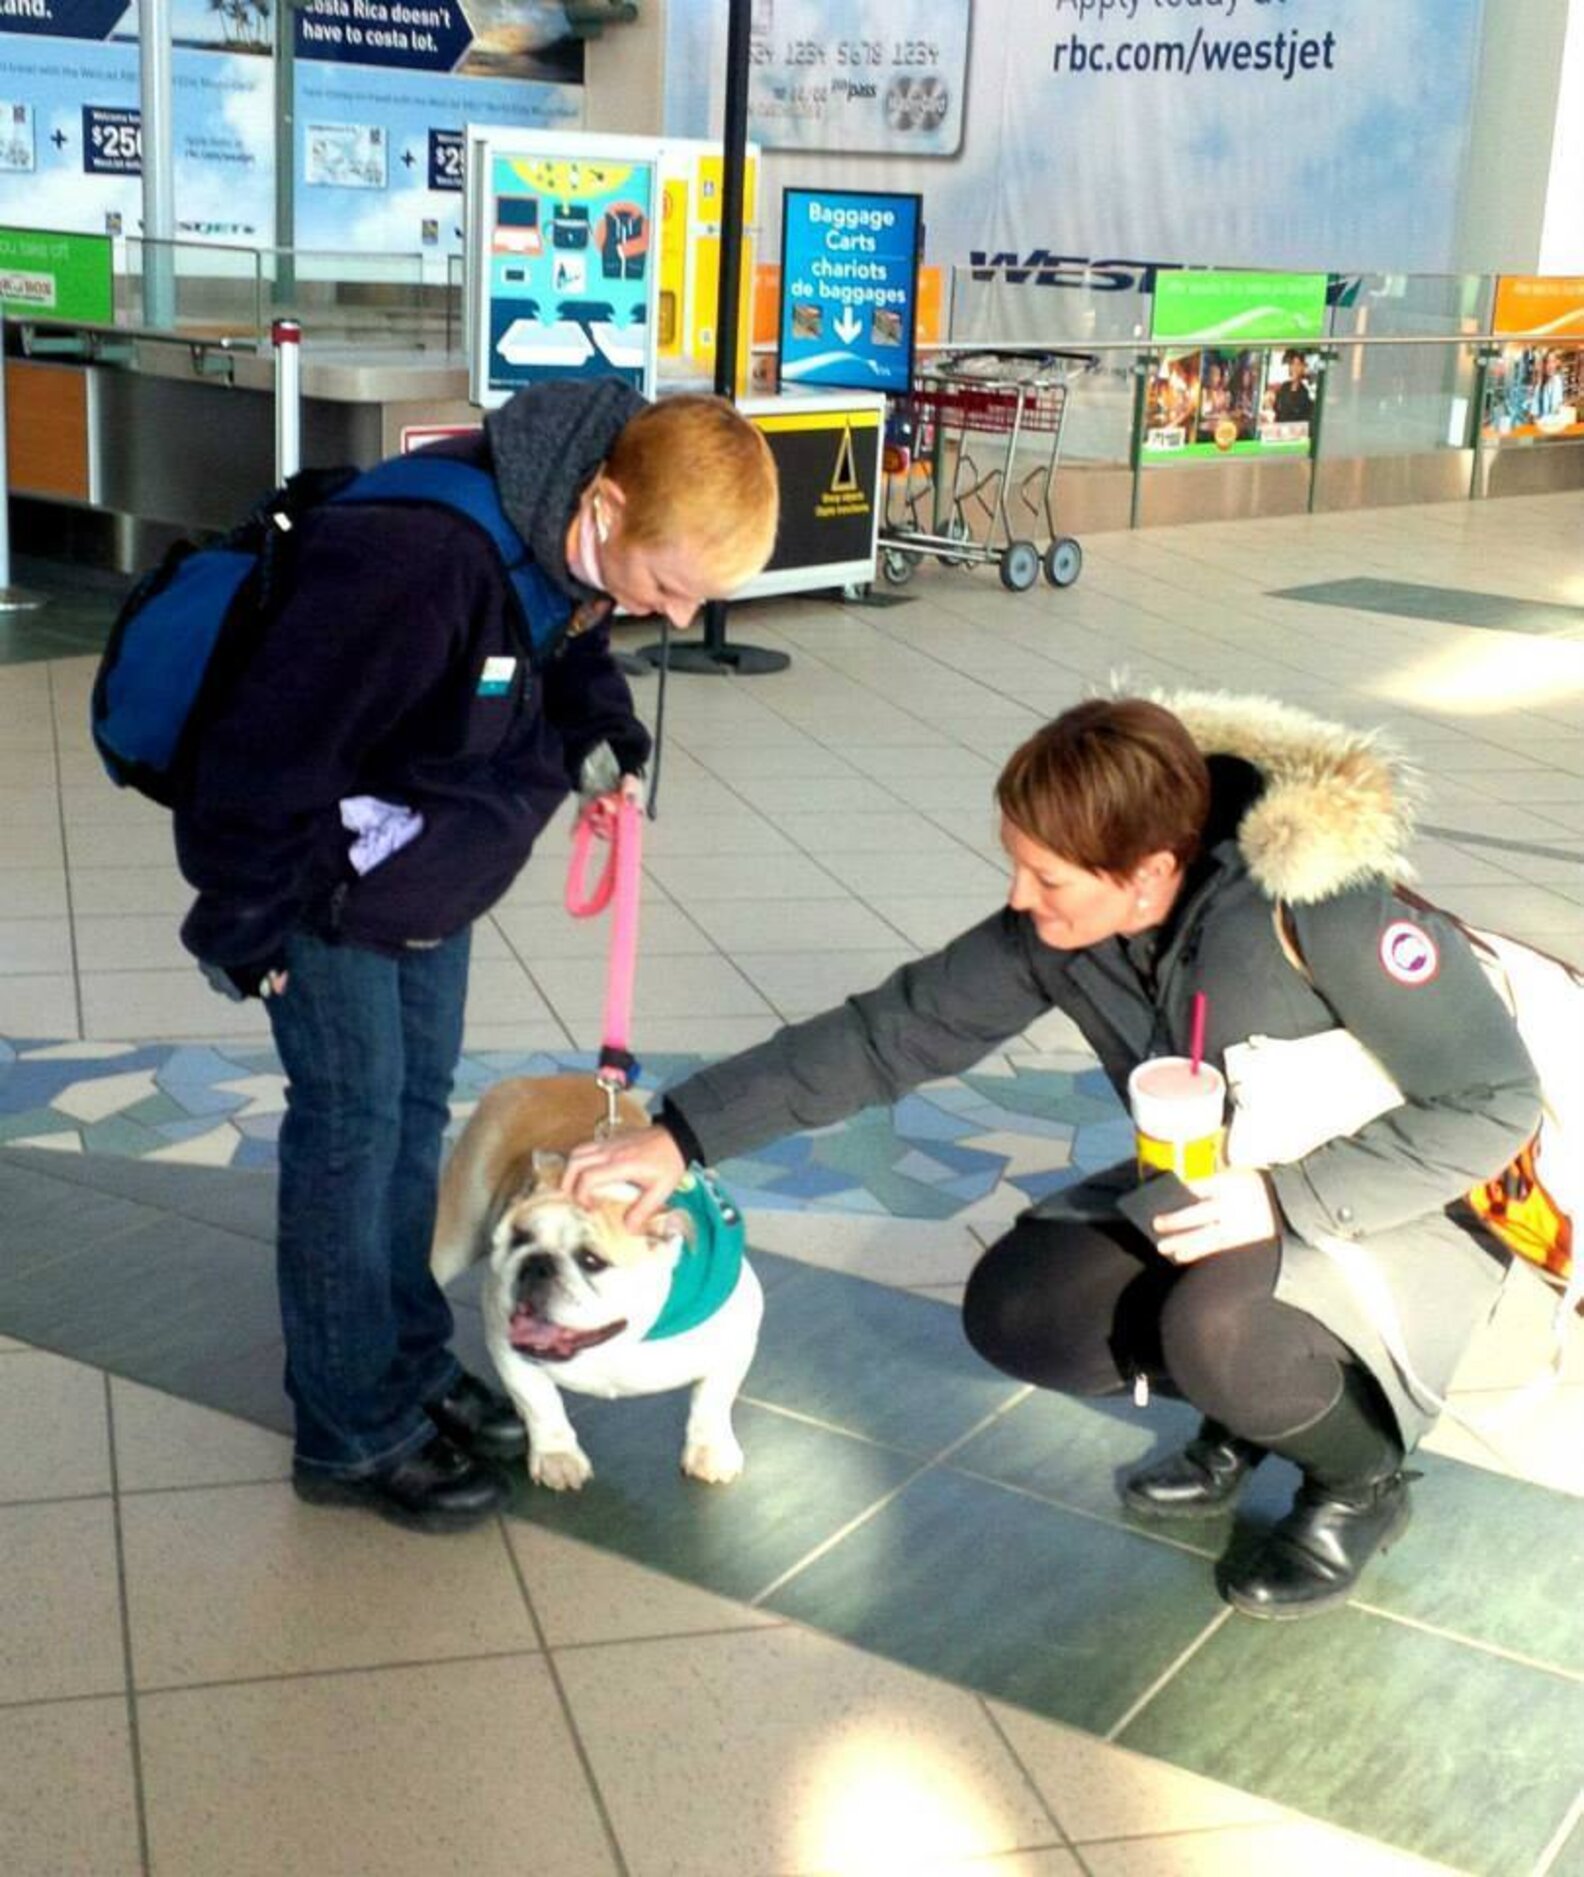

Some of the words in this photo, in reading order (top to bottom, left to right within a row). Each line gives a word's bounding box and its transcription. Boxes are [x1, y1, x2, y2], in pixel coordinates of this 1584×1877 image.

[0, 0, 53, 19] and.
[354, 0, 388, 21] Rica
[391, 3, 451, 29] doesn't
[302, 18, 343, 43] have
[346, 25, 362, 44] to
[365, 29, 408, 49] costa
[412, 30, 439, 52] lot.
[1052, 26, 1336, 80] rbc.com/westjet
[436, 145, 463, 175] $2
[808, 201, 895, 231] Baggage
[826, 229, 876, 252] Carts
[811, 255, 887, 280] chariots
[969, 249, 1225, 294] WEST
[791, 278, 814, 298] de
[819, 280, 907, 306] baggages
